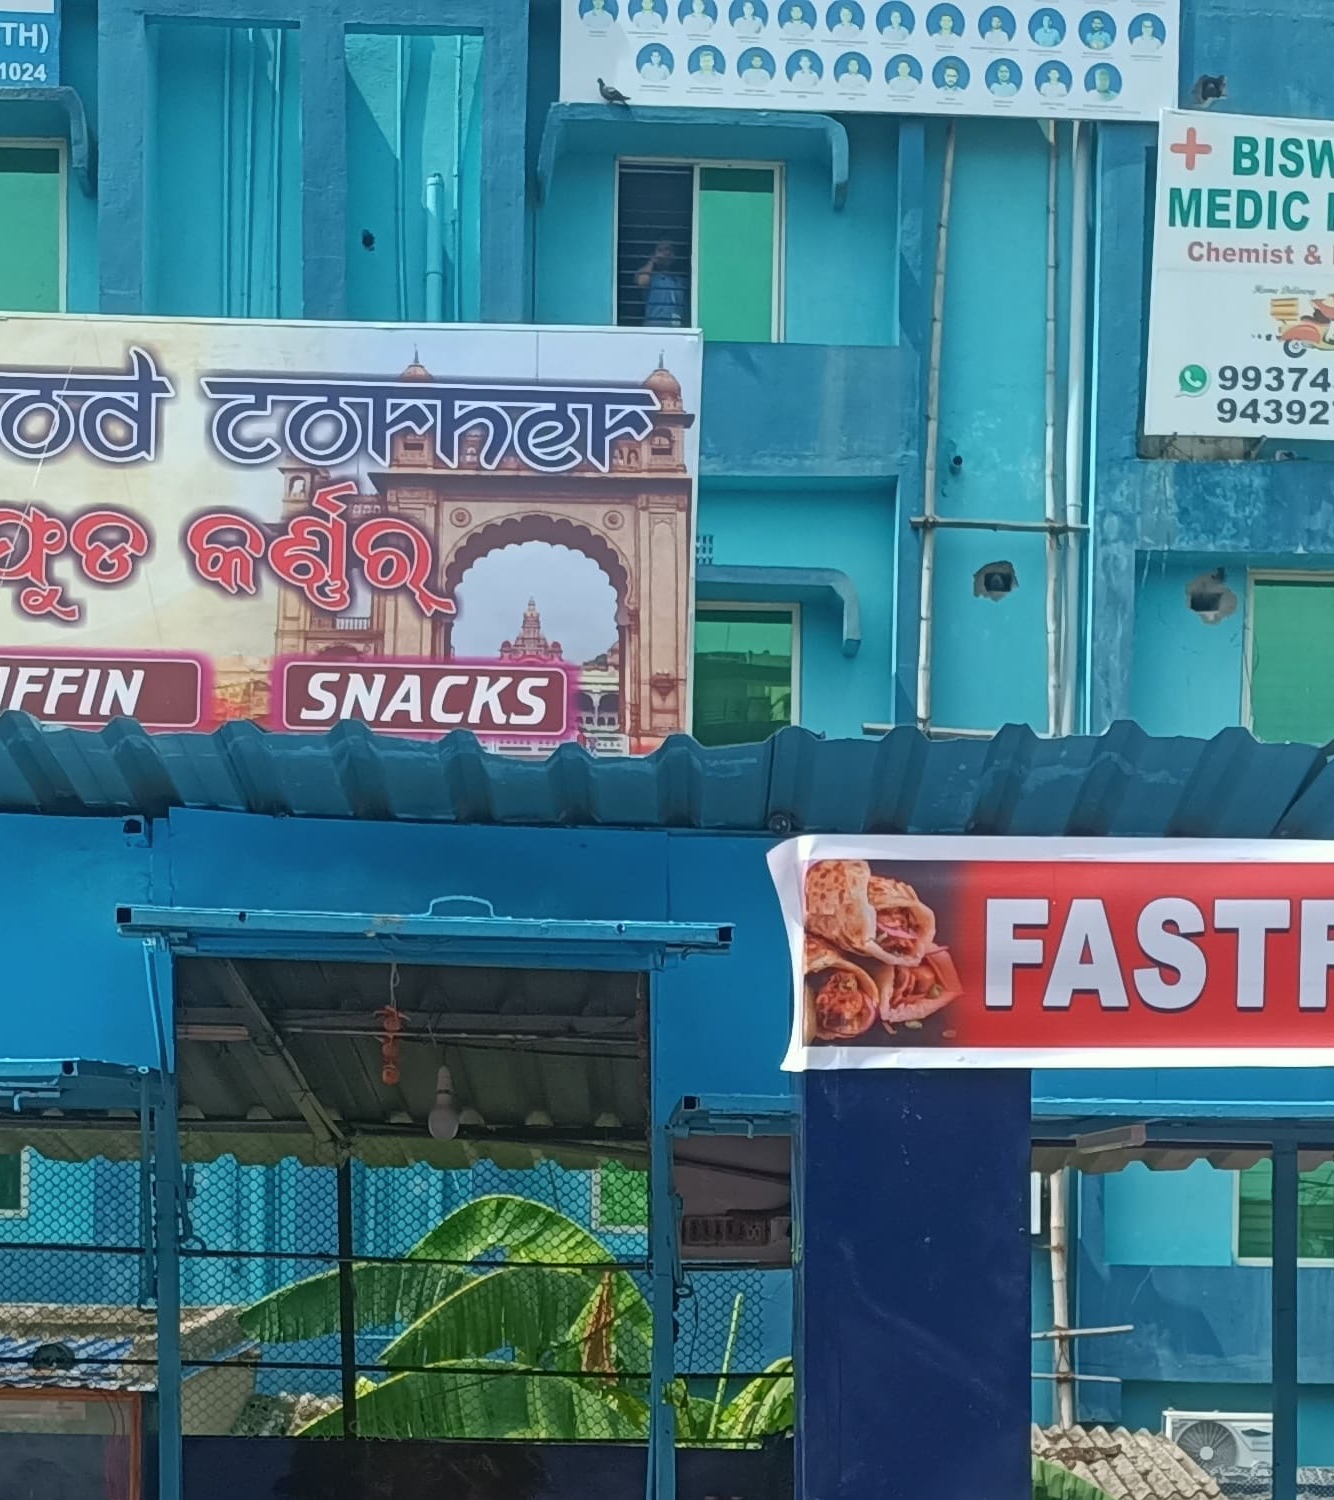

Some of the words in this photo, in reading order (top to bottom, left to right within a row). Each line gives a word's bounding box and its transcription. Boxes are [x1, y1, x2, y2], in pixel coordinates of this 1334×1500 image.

[1168, 188, 1310, 231] MEDIC
[1187, 241, 1294, 265] Chemist
[1304, 244, 1322, 265] &
[203, 375, 662, 475] corner
[298, 666, 548, 725] SNACKS
